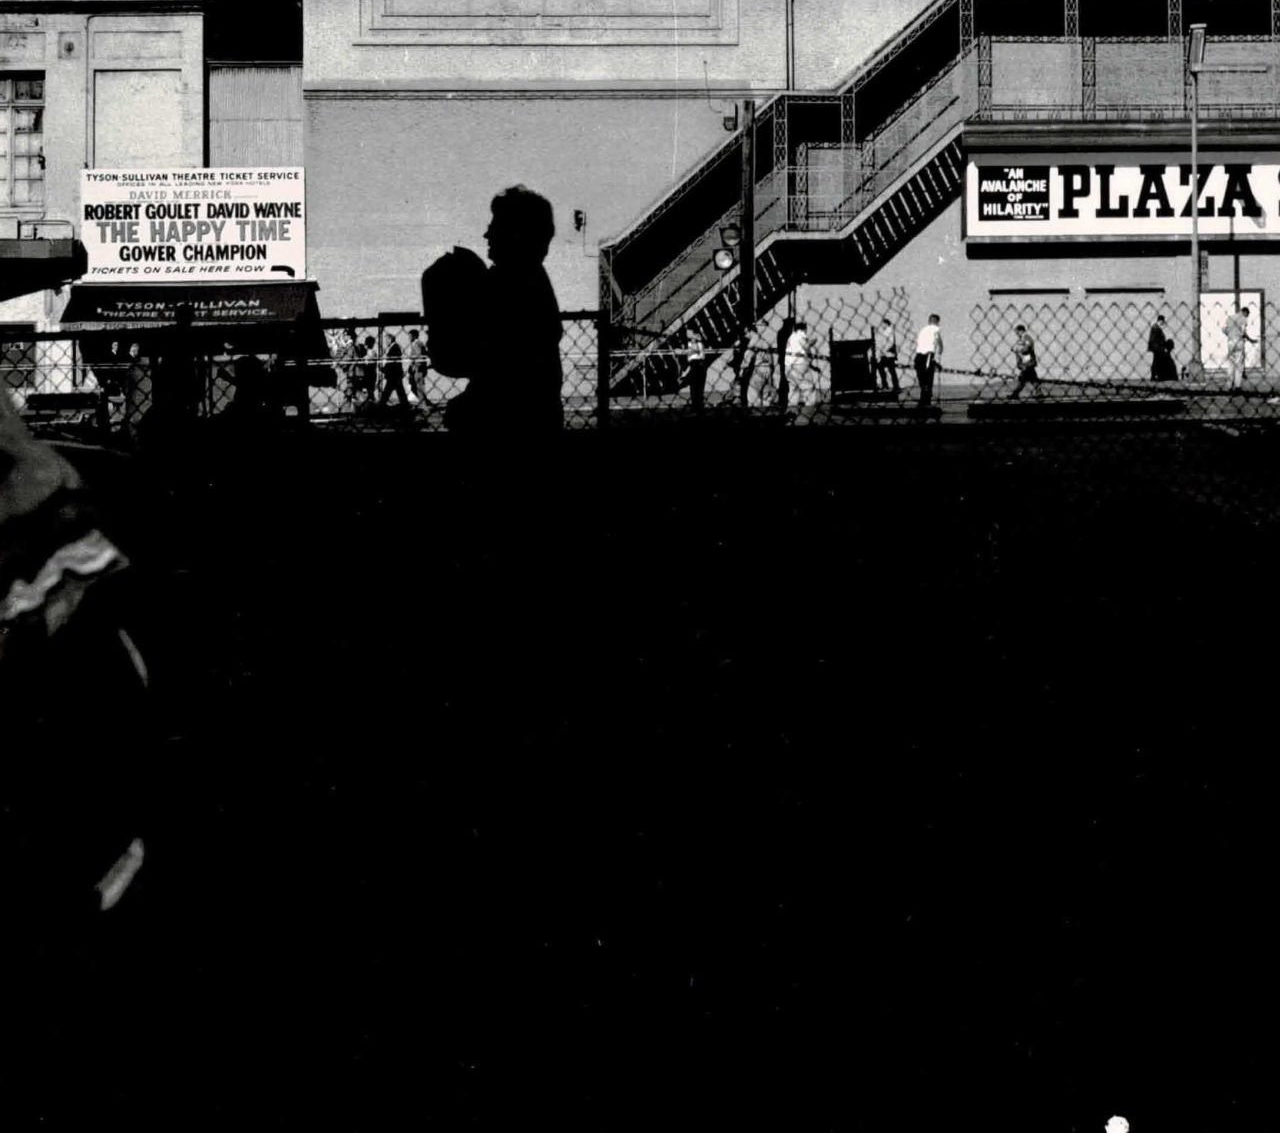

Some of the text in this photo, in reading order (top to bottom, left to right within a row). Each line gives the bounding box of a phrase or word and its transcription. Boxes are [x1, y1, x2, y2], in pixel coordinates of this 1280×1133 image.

[172, 172, 216, 181] THEATRE
[220, 172, 253, 180] TICKET
[257, 171, 300, 180] SERVICE
[980, 180, 1047, 192] AVALANCHE
[1058, 164, 1263, 219] PLAZA
[129, 190, 167, 200] DAVID
[173, 190, 232, 200] MERRICK
[1007, 193, 1023, 203] OF
[84, 202, 302, 220] ROBERT GOULET DAVID WAYNE
[96, 219, 292, 244] THE HAPPY TIME
[119, 244, 267, 262] GOWER CHAMPION
[91, 265, 266, 274] TICKETS ON SALE HERE NOW
[103, 310, 160, 318] THEATRE
[212, 308, 268, 317] SERVICE
